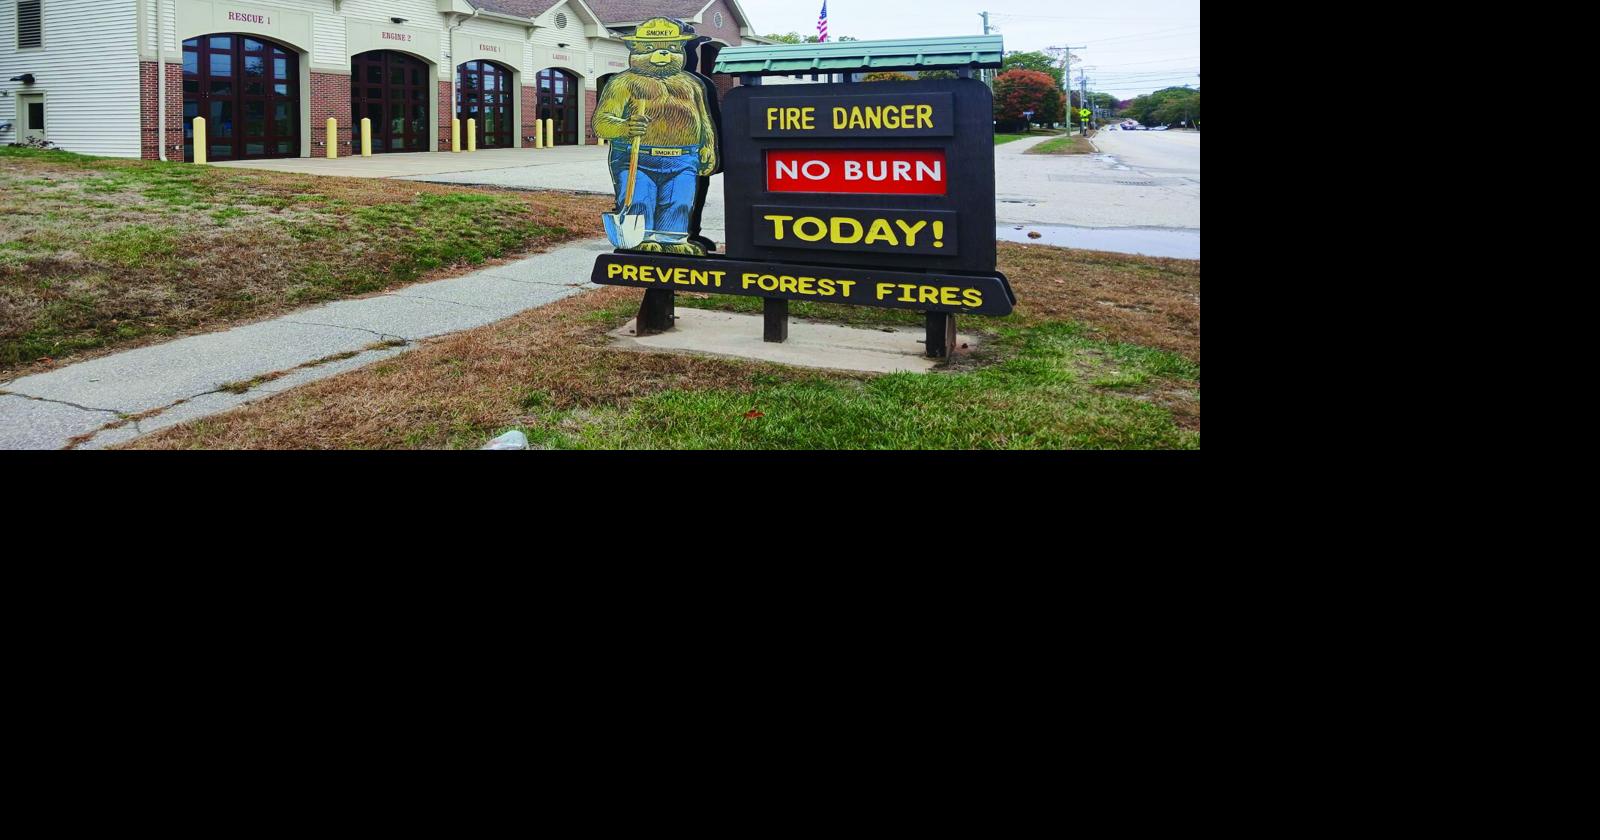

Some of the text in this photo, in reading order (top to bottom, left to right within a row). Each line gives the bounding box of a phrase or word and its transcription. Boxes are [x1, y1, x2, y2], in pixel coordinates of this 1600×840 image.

[228, 11, 264, 24] RESCUE
[382, 31, 412, 42] ENGINE 2
[767, 104, 934, 131] FIRE DANGER
[775, 160, 942, 182] NO BURN
[764, 214, 945, 249] TODAY!
[607, 263, 983, 308] PREVENT FOREST FIRES
